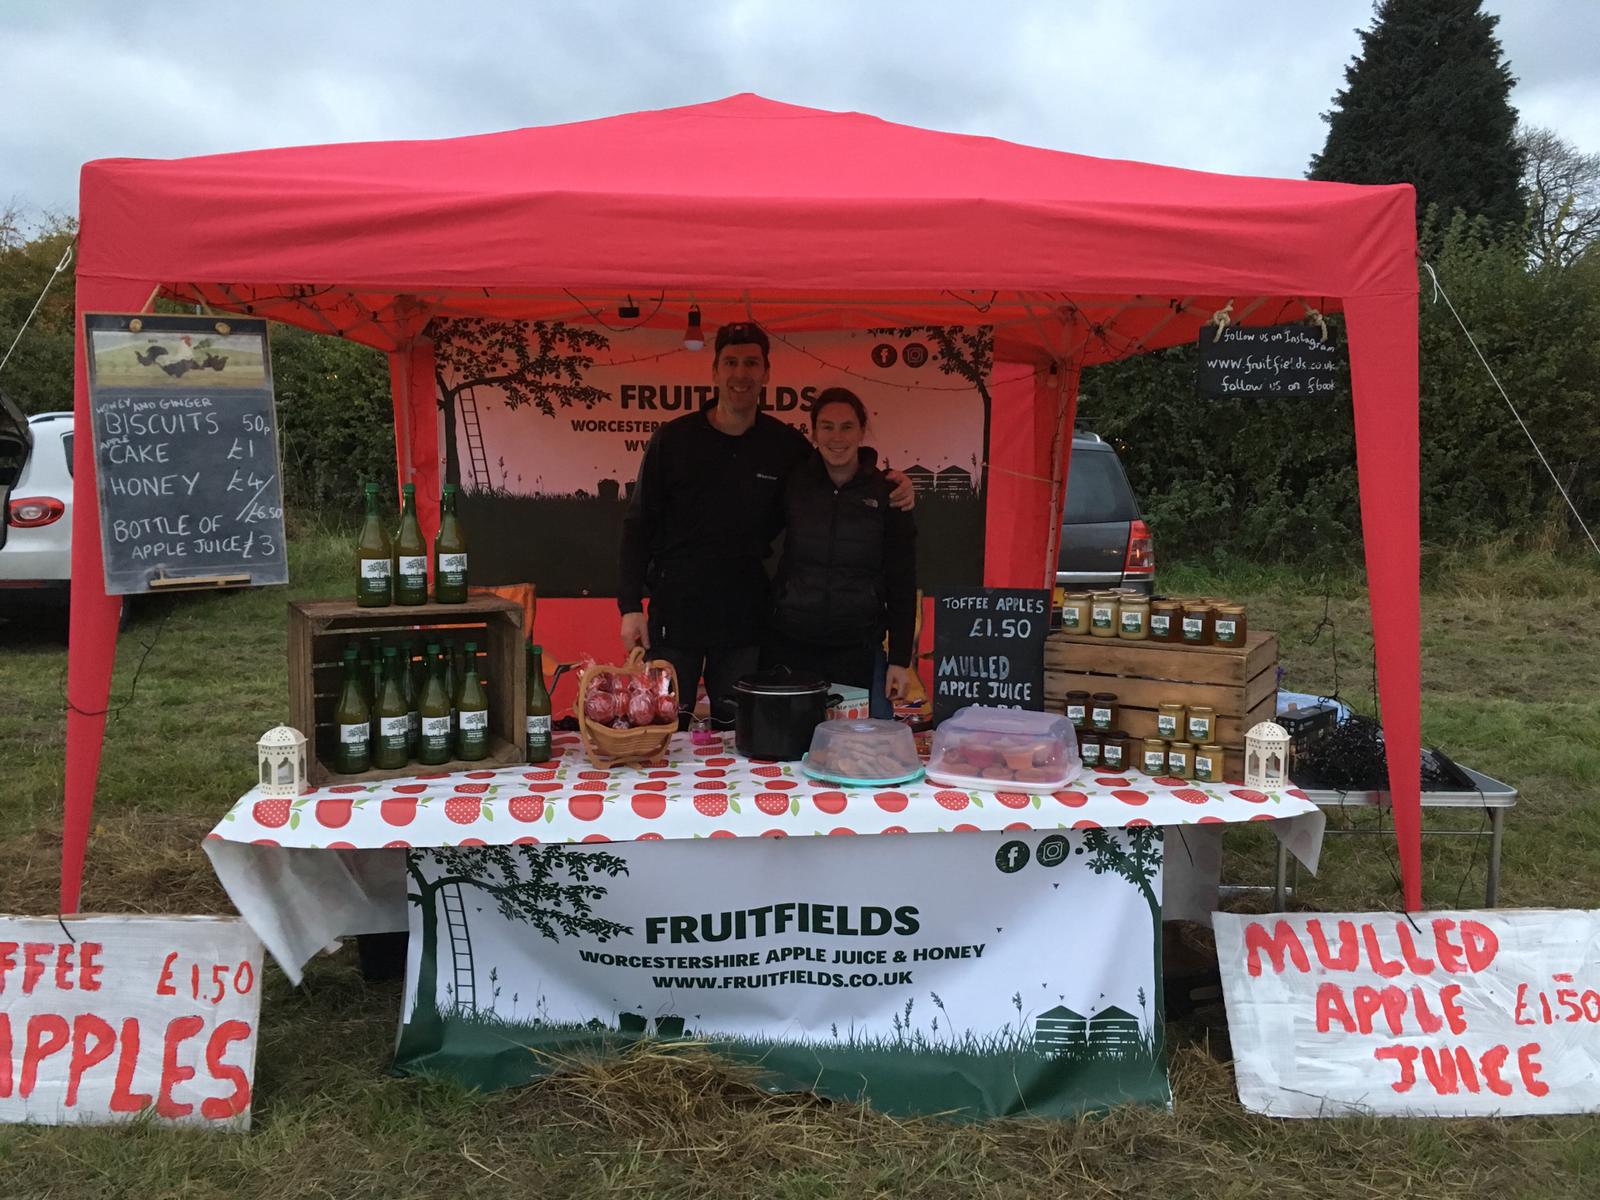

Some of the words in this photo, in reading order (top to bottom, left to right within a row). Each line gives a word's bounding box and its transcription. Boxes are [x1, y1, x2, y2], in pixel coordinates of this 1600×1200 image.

[1224, 328, 1255, 342] follow
[1259, 334, 1269, 343] us
[1271, 332, 1282, 342] on
[1284, 330, 1335, 353] Instagram
[1221, 375, 1263, 392] follow
[1269, 380, 1281, 391] us
[1288, 381, 1301, 391] on
[133, 401, 156, 412] AND
[159, 397, 212, 410] GINGER
[105, 412, 219, 435] BISCUITS
[242, 413, 270, 436] 50p
[109, 443, 169, 464] CAKE
[110, 472, 200, 496] HONEY
[113, 514, 191, 542] BOTTLE
[200, 515, 223, 534] OF
[131, 542, 188, 559] APPLE
[193, 535, 241, 553] JUICE
[942, 597, 989, 611] TOFFEE
[995, 596, 1045, 614] APPLES
[968, 618, 1031, 638] £1.50
[937, 655, 1010, 679] MULLED
[938, 680, 984, 697] APPLE
[988, 682, 1032, 701] JUICE
[645, 902, 921, 944] FRUITFIELDS
[579, 949, 760, 970] WORCESTERSHIRE
[765, 946, 827, 965] APPLE
[832, 949, 887, 965] JUICE
[891, 949, 908, 964] &
[913, 943, 986, 962] HONEY
[1244, 918, 1499, 977] MULLED
[156, 951, 254, 1004] £1.50
[652, 969, 913, 989] WWW.FRUITFIELDS.CO.UK
[1315, 981, 1467, 1036] APPLE
[1373, 1042, 1549, 1097] JUICE
